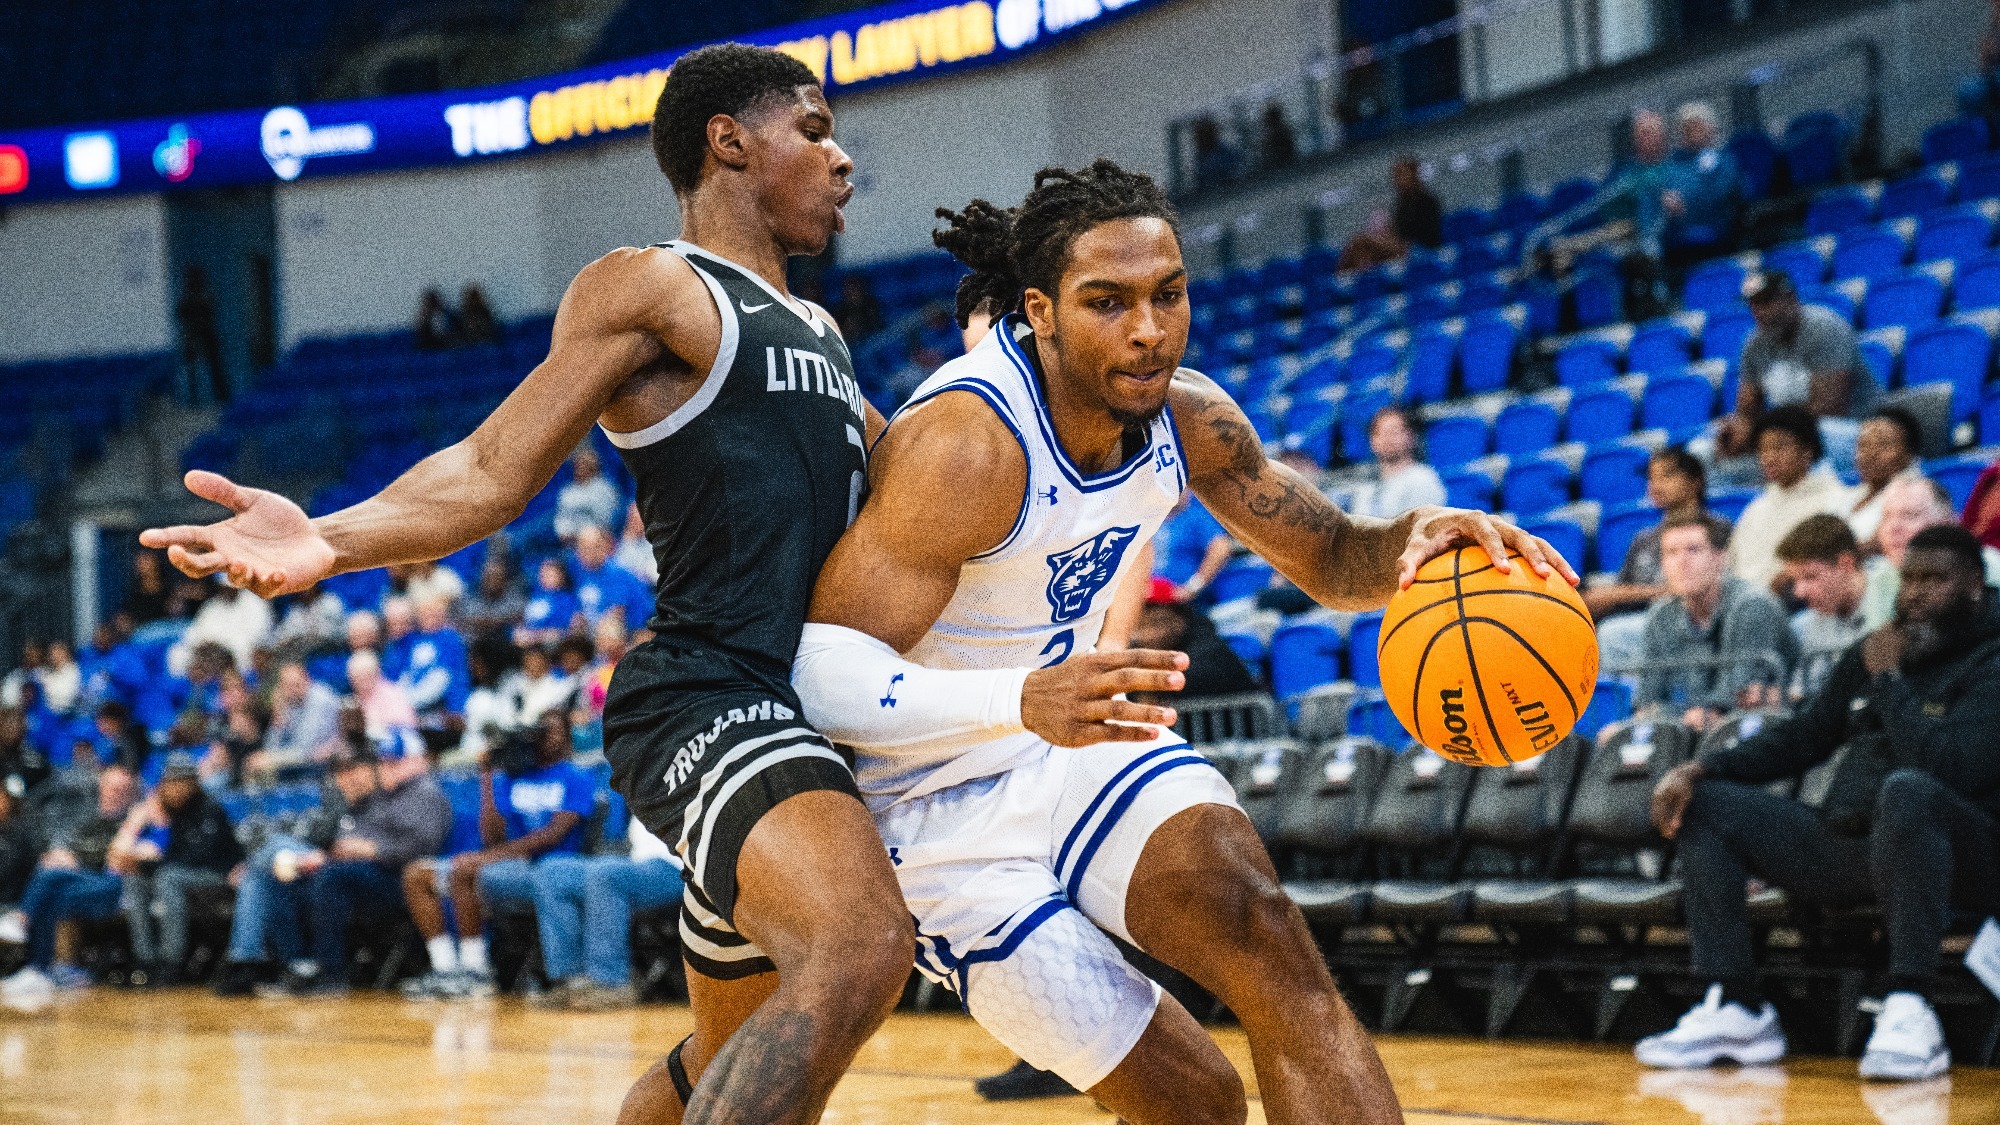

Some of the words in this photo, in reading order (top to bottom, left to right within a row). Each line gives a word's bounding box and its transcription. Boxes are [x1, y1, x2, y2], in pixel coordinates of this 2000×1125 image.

[445, 95, 530, 157] THE
[830, 0, 996, 85] LAWYER
[1439, 686, 1488, 767] ilson
[1500, 681, 1522, 705] NXT
[662, 700, 796, 797] TROJANS
